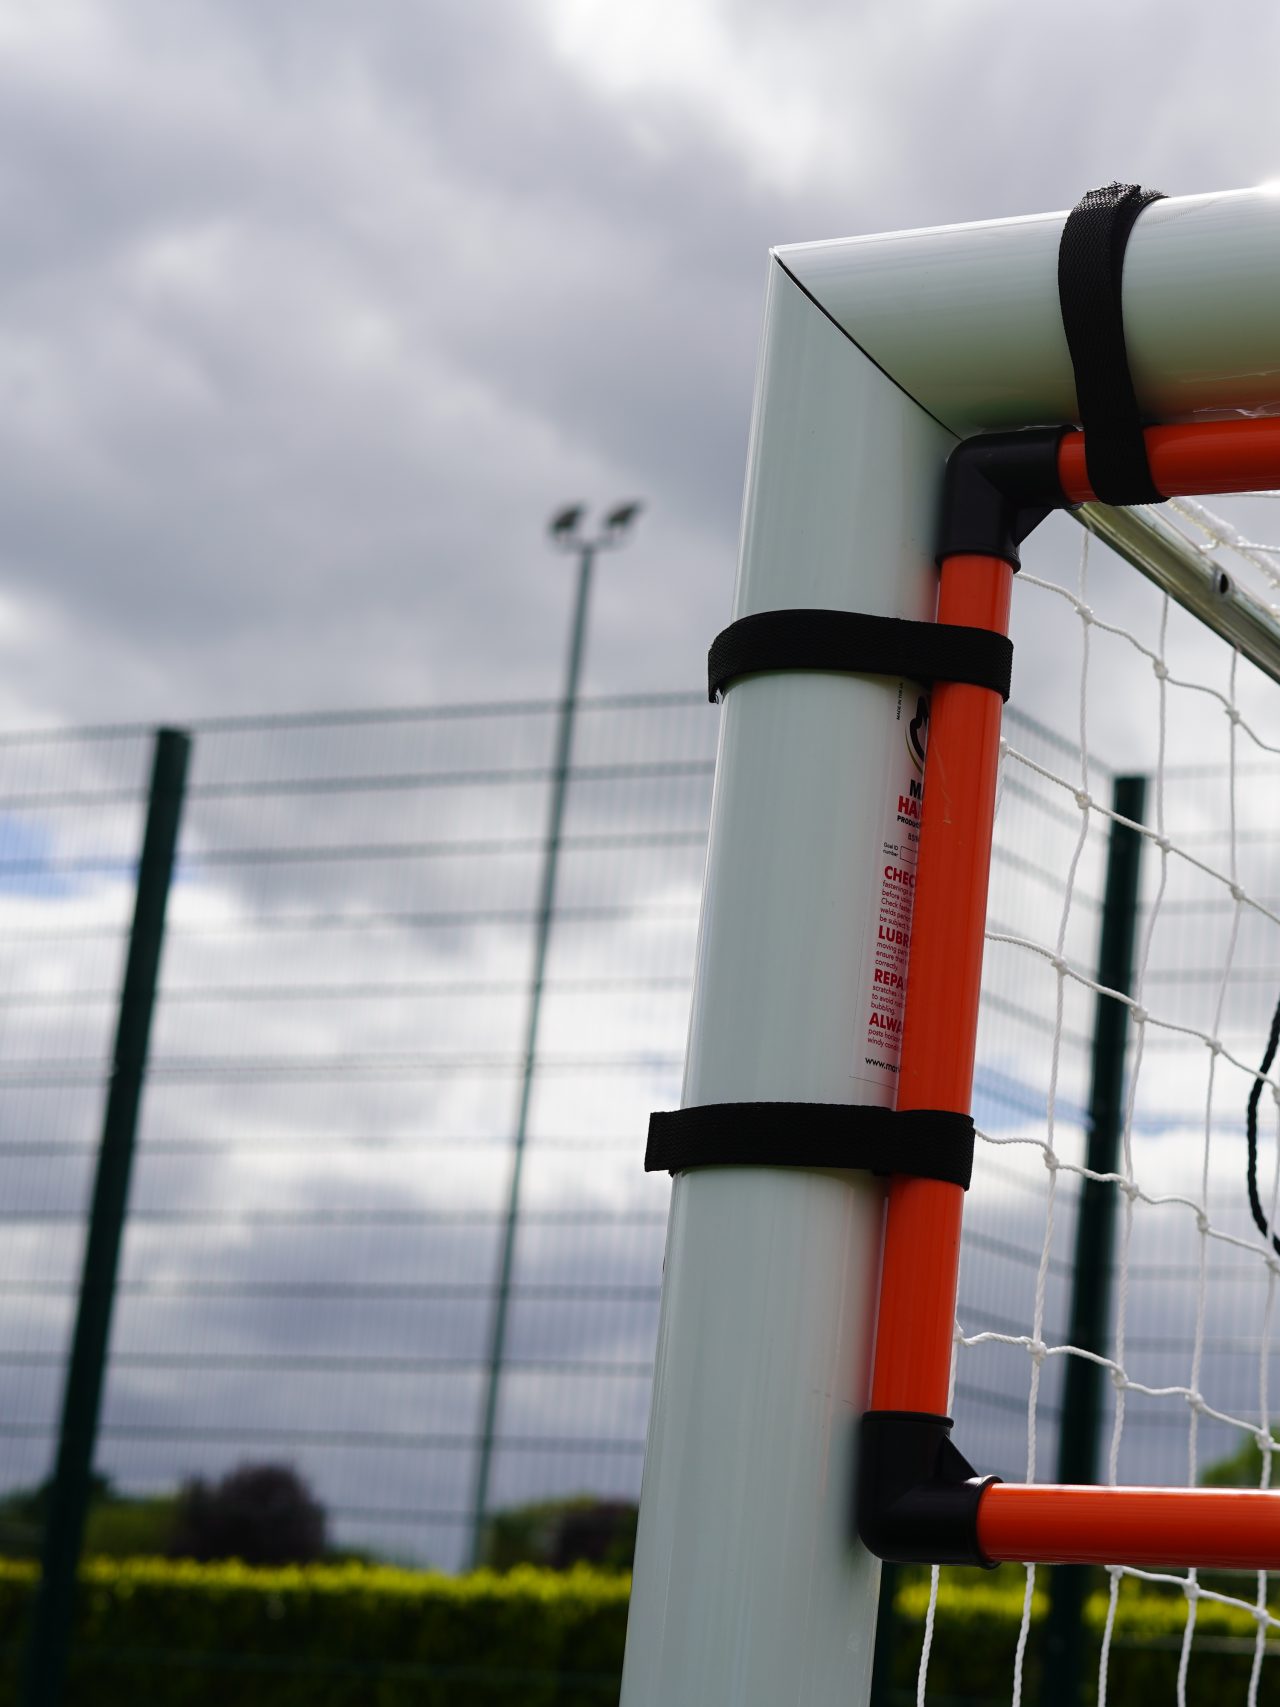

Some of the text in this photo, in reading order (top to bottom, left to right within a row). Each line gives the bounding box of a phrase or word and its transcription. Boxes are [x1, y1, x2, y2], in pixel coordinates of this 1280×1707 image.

[910, 779, 922, 800] M
[884, 865, 915, 888] CHEC
[881, 897, 898, 908] Check
[878, 925, 910, 948] LUBR
[874, 968, 904, 990] REPA
[869, 1012, 902, 1033] ALWA
